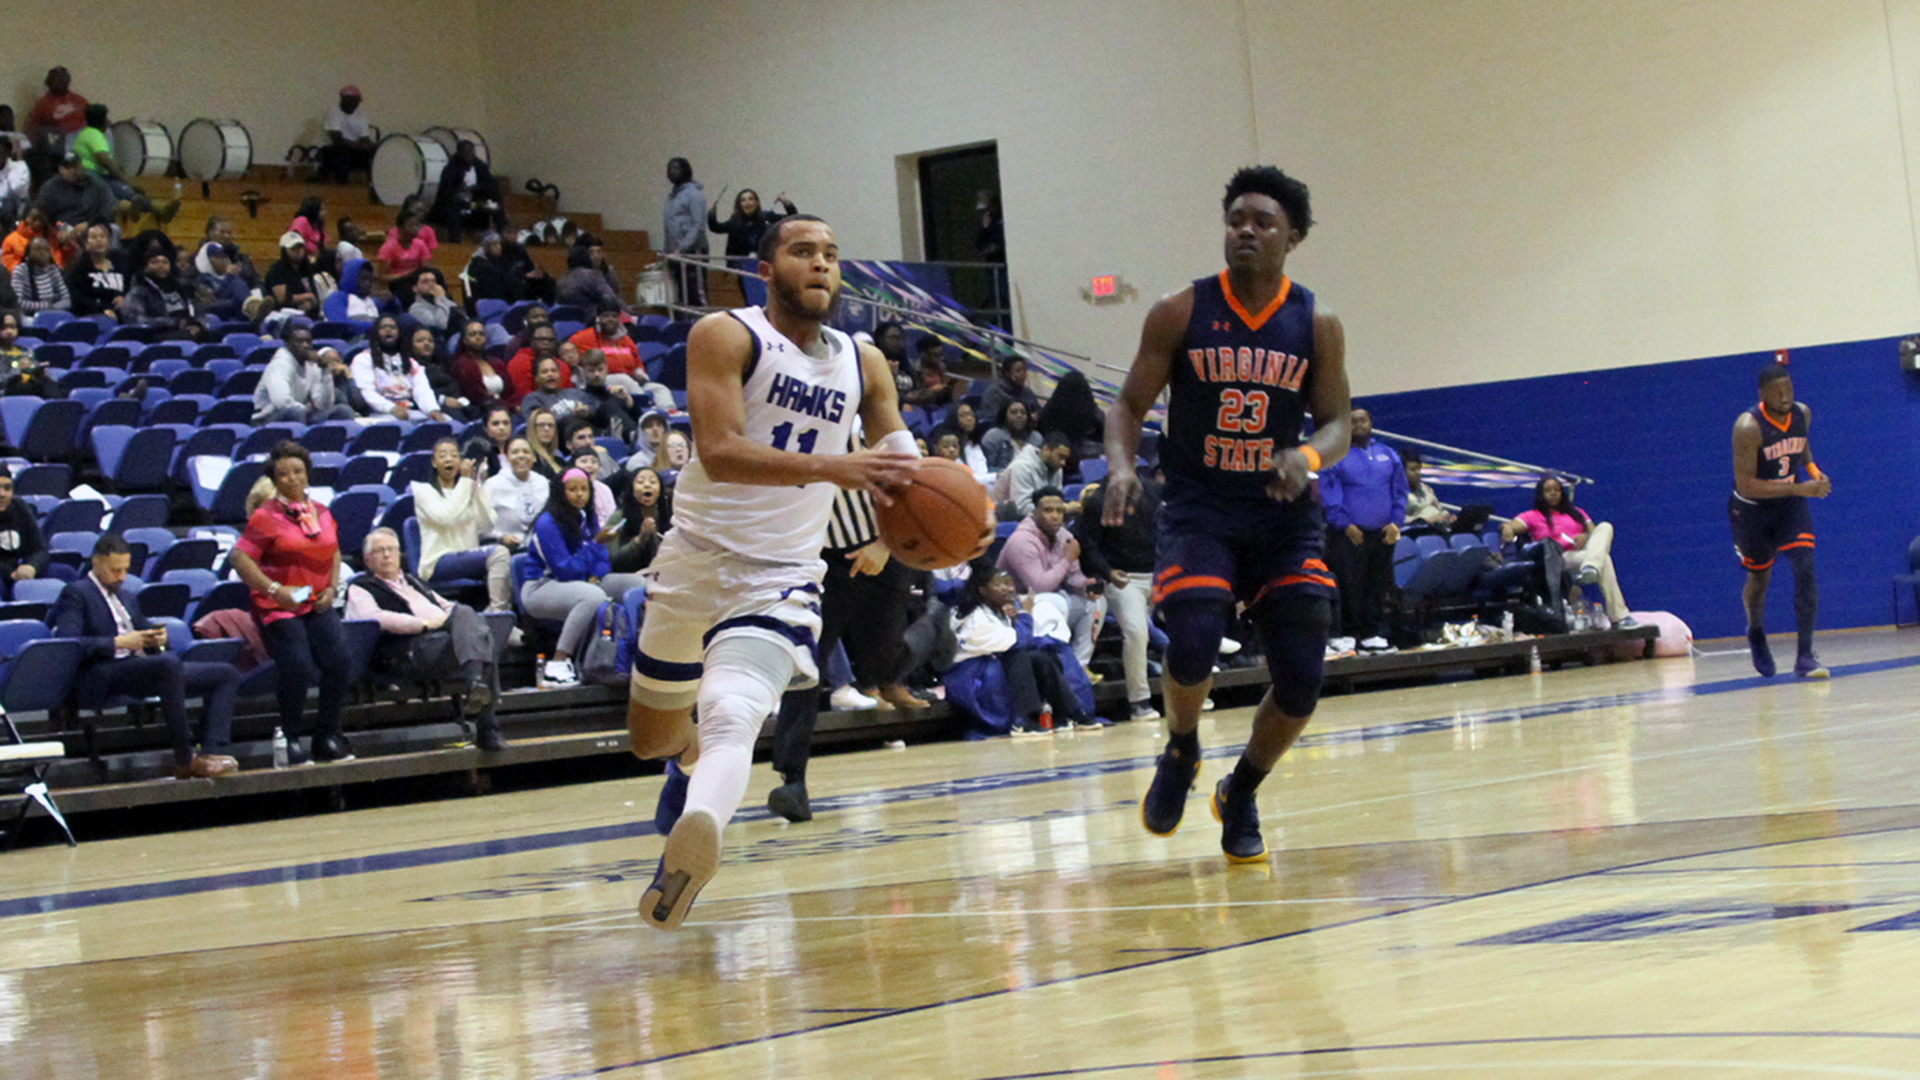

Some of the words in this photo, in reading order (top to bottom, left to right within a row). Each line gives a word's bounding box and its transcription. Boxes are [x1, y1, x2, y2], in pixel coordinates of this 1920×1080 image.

[1188, 346, 1309, 392] VIRGINIA
[766, 372, 846, 424] HAWKS
[1217, 387, 1269, 434] 23
[771, 421, 819, 454] 11
[1203, 434, 1274, 471] STATE
[1778, 456, 1790, 476] 3
